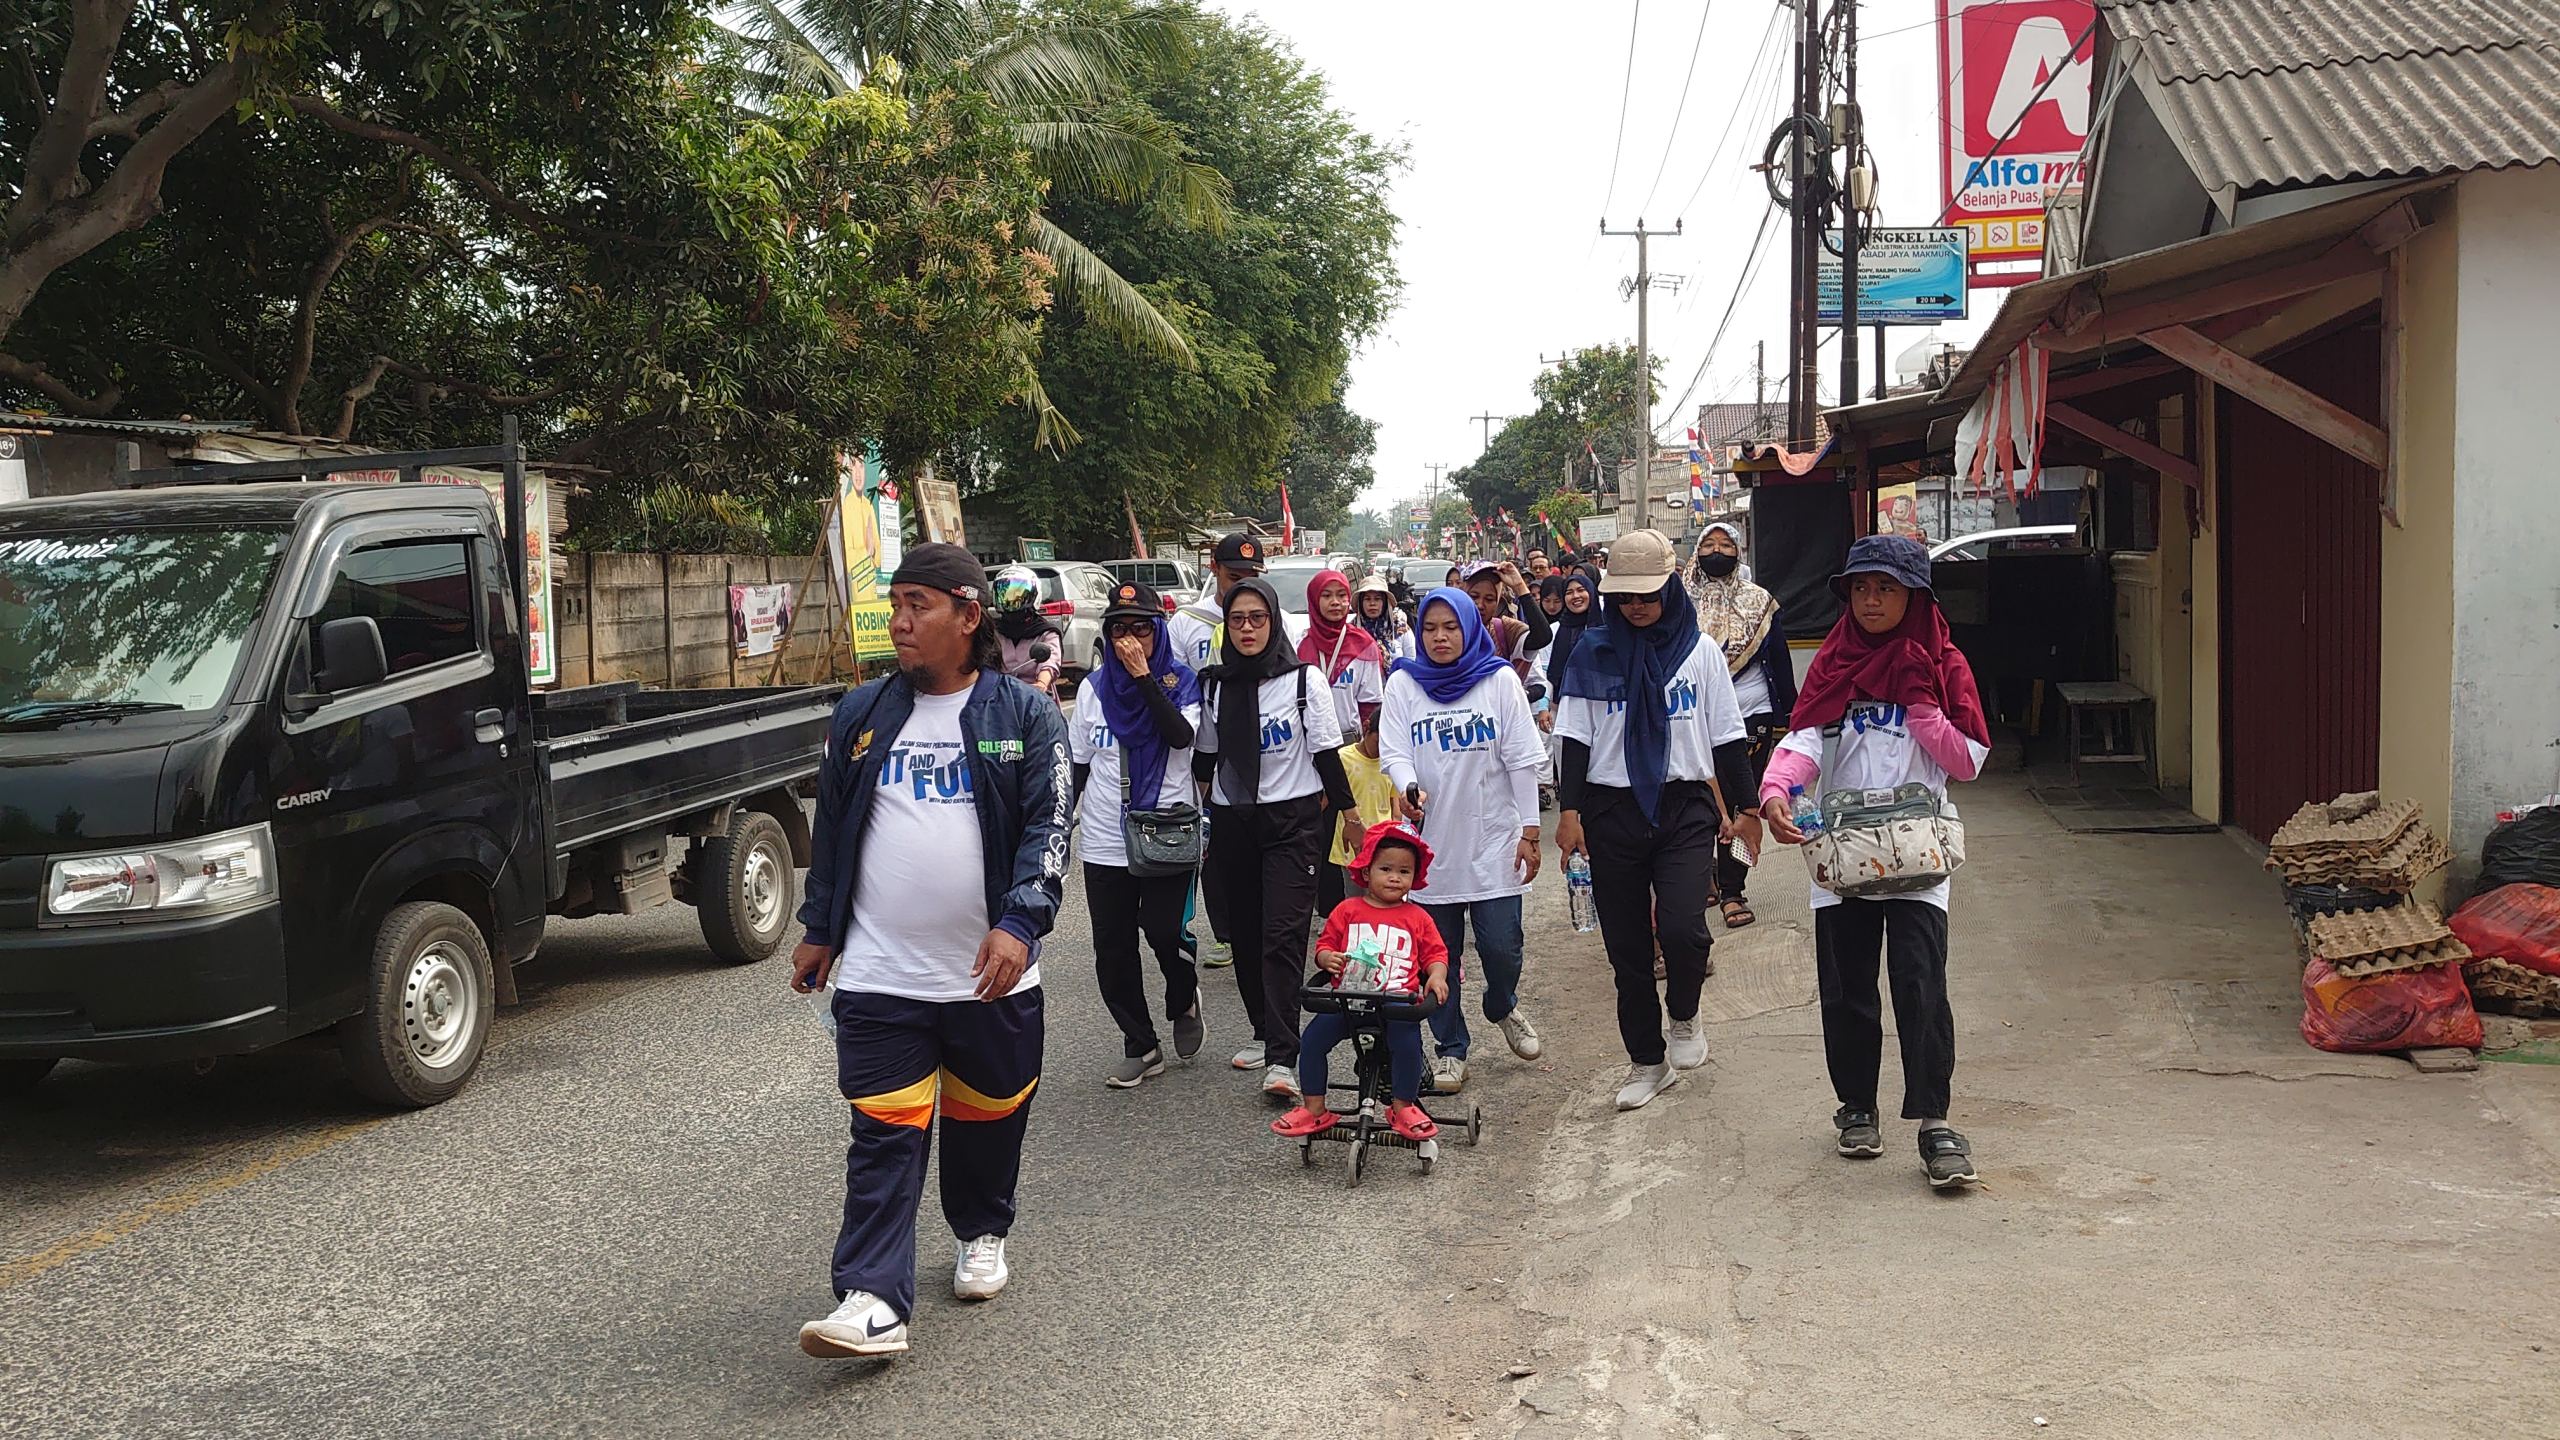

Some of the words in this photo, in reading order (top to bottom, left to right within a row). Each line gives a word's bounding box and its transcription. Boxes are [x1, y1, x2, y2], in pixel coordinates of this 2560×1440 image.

[1963, 190, 2007, 208] Belanja
[2010, 189, 2042, 205] Puas,
[1872, 232, 1925, 243] NGKEL
[1929, 232, 1958, 243] LAS
[1860, 250, 1886, 258] ABADI
[1888, 250, 1910, 258] JAYA
[1912, 250, 1951, 258] MAKMUR
[855, 612, 890, 631] ROBINS
[1410, 717, 1434, 748] FIT
[1435, 717, 1454, 731] AND
[1261, 718, 1293, 750] UN
[1438, 717, 1496, 752] FUN
[977, 740, 1023, 754] CILEGON
[881, 748, 910, 787] IT
[907, 753, 936, 771] AND
[276, 787, 332, 810] CARRY
